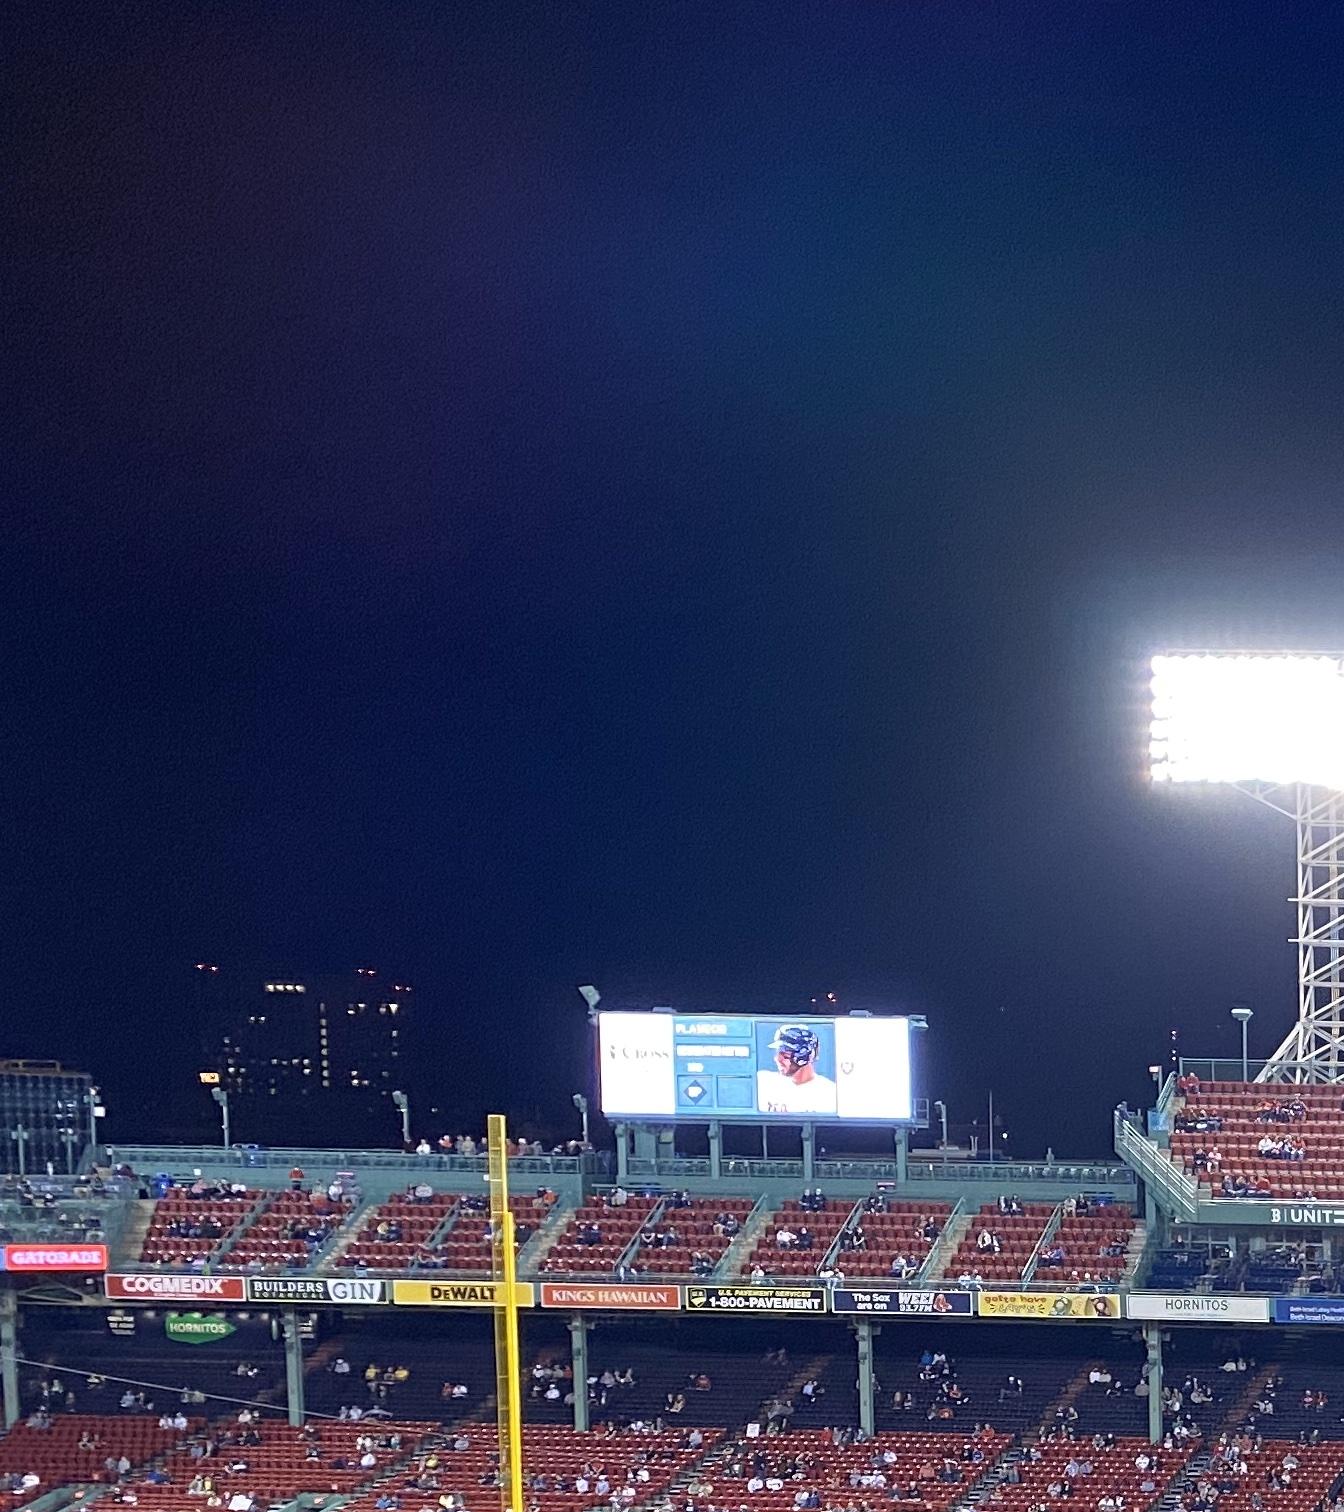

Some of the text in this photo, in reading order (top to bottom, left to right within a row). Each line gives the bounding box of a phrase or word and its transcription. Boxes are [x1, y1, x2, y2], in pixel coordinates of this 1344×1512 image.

[12, 1251, 102, 1265] GATORADE
[122, 1277, 224, 1294] COGMEDIX
[253, 1281, 324, 1293] BUILDERS
[332, 1282, 375, 1300] GIN
[598, 1290, 668, 1304] HAWAIIAN
[709, 1296, 821, 1310] 1-800-PAVEMENT
[852, 1293, 891, 1302] The Sox
[898, 1292, 935, 1304] WEEI
[856, 1302, 888, 1310] are on
[1165, 1299, 1229, 1311] HORNITOS
[169, 1322, 226, 1334] HORNITOS
